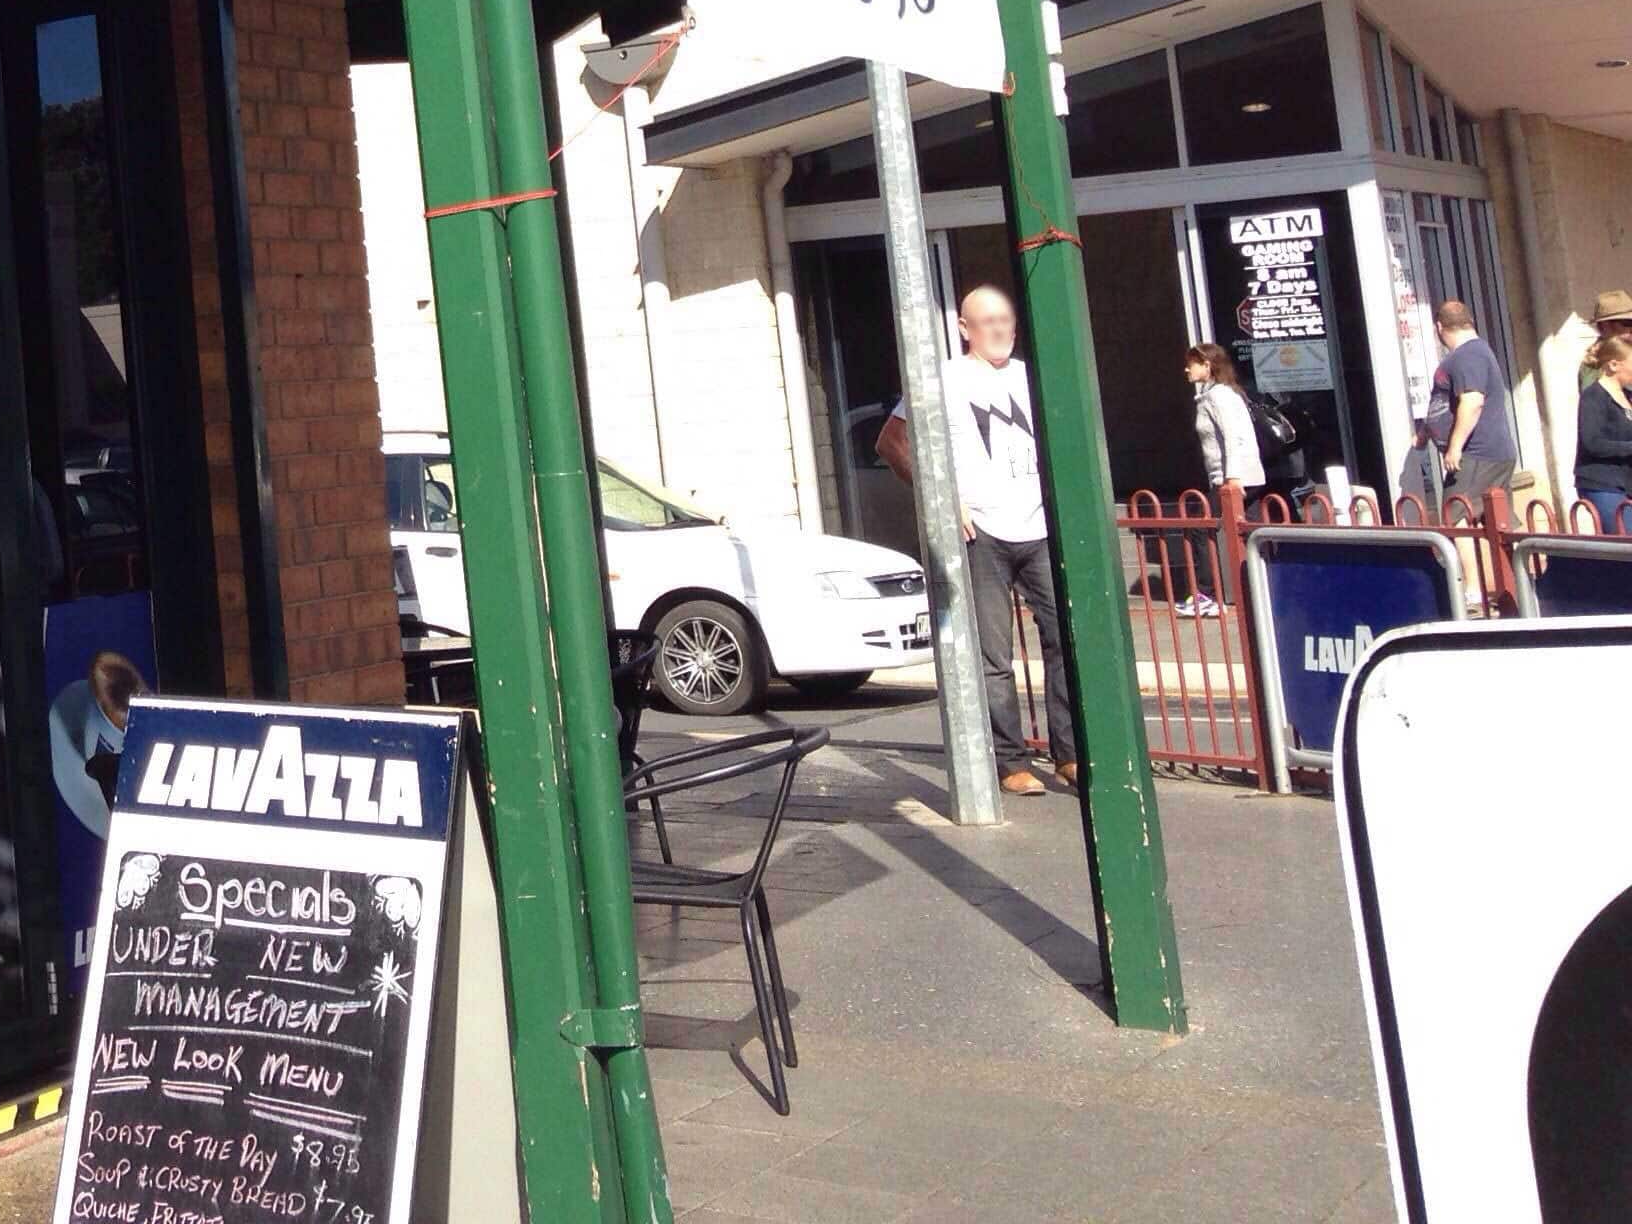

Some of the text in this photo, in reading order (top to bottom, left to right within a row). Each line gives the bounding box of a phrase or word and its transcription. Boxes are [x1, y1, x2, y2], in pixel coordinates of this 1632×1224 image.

[1240, 214, 1313, 237] ATM
[1241, 239, 1314, 257] GAMING
[1252, 252, 1305, 267] ROOM
[1274, 267, 1308, 281] am
[1248, 280, 1318, 295] 7 Days
[1304, 625, 1374, 674] LAVA
[136, 724, 424, 828] LAVAZZA
[179, 862, 357, 928] Specials
[112, 923, 218, 967] UNDER
[259, 933, 348, 974] NEW
[134, 978, 370, 1035] MANAGEMENT
[92, 1032, 346, 1096] NEW LOOK MENU
[87, 1110, 163, 1148] ROAST
[193, 1136, 234, 1162] THE
[239, 1133, 278, 1187] DAY
[77, 1152, 131, 1189] SOUP
[154, 1165, 223, 1206] CRUSTY
[230, 1175, 307, 1216] BREAD
